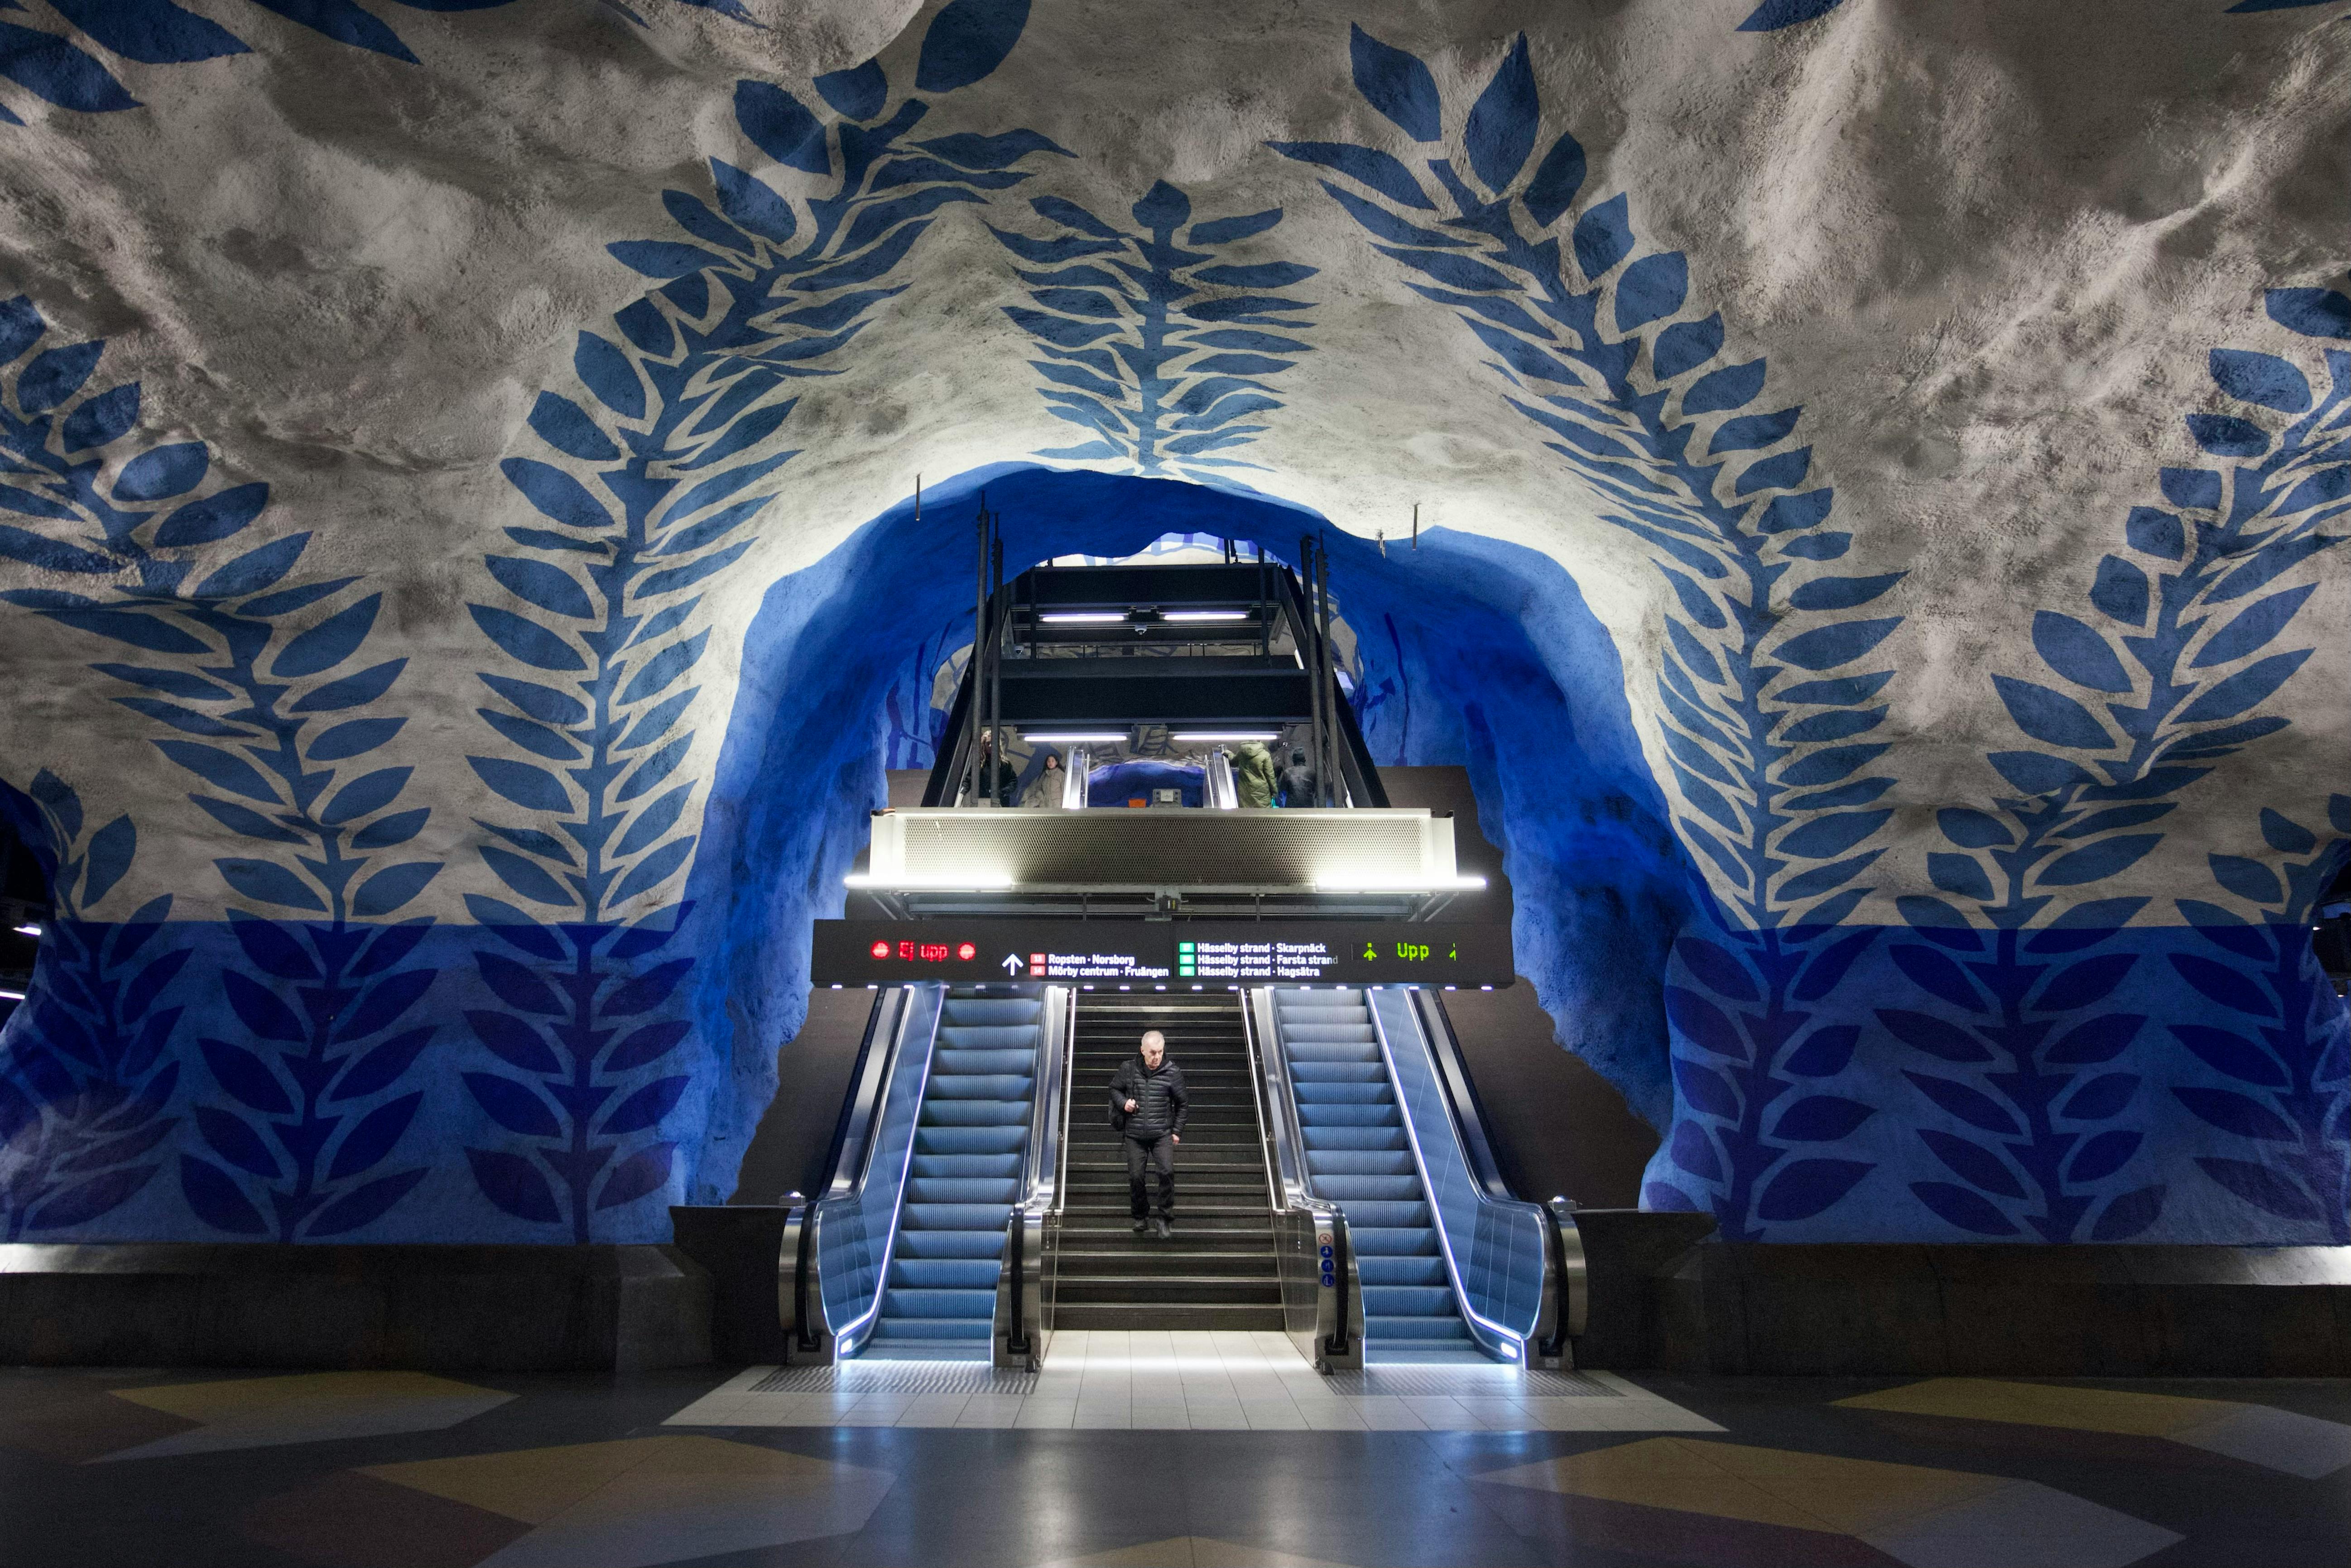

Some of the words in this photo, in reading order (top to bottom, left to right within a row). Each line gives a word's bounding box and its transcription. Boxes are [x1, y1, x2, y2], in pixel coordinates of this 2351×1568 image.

[919, 944, 949, 962] upp
[1197, 943, 1238, 954] Hässelby
[1240, 943, 1270, 953] strand
[1276, 943, 1326, 954] Skarpnäck
[1397, 942, 1429, 961] Upp
[1048, 954, 1086, 965] Ropsten
[1092, 954, 1135, 966] Norsborg
[1198, 954, 1239, 966] Hässelby
[1240, 955, 1270, 964] strand
[1277, 955, 1307, 964] Farsta
[1308, 955, 1338, 964] strand
[1048, 966, 1078, 978] Mörby
[1080, 967, 1119, 976] centrum
[1125, 966, 1169, 978] Fruängen
[1198, 966, 1239, 978] Hässelby
[1240, 966, 1270, 976] strand
[1277, 966, 1320, 978] Hagsätra
